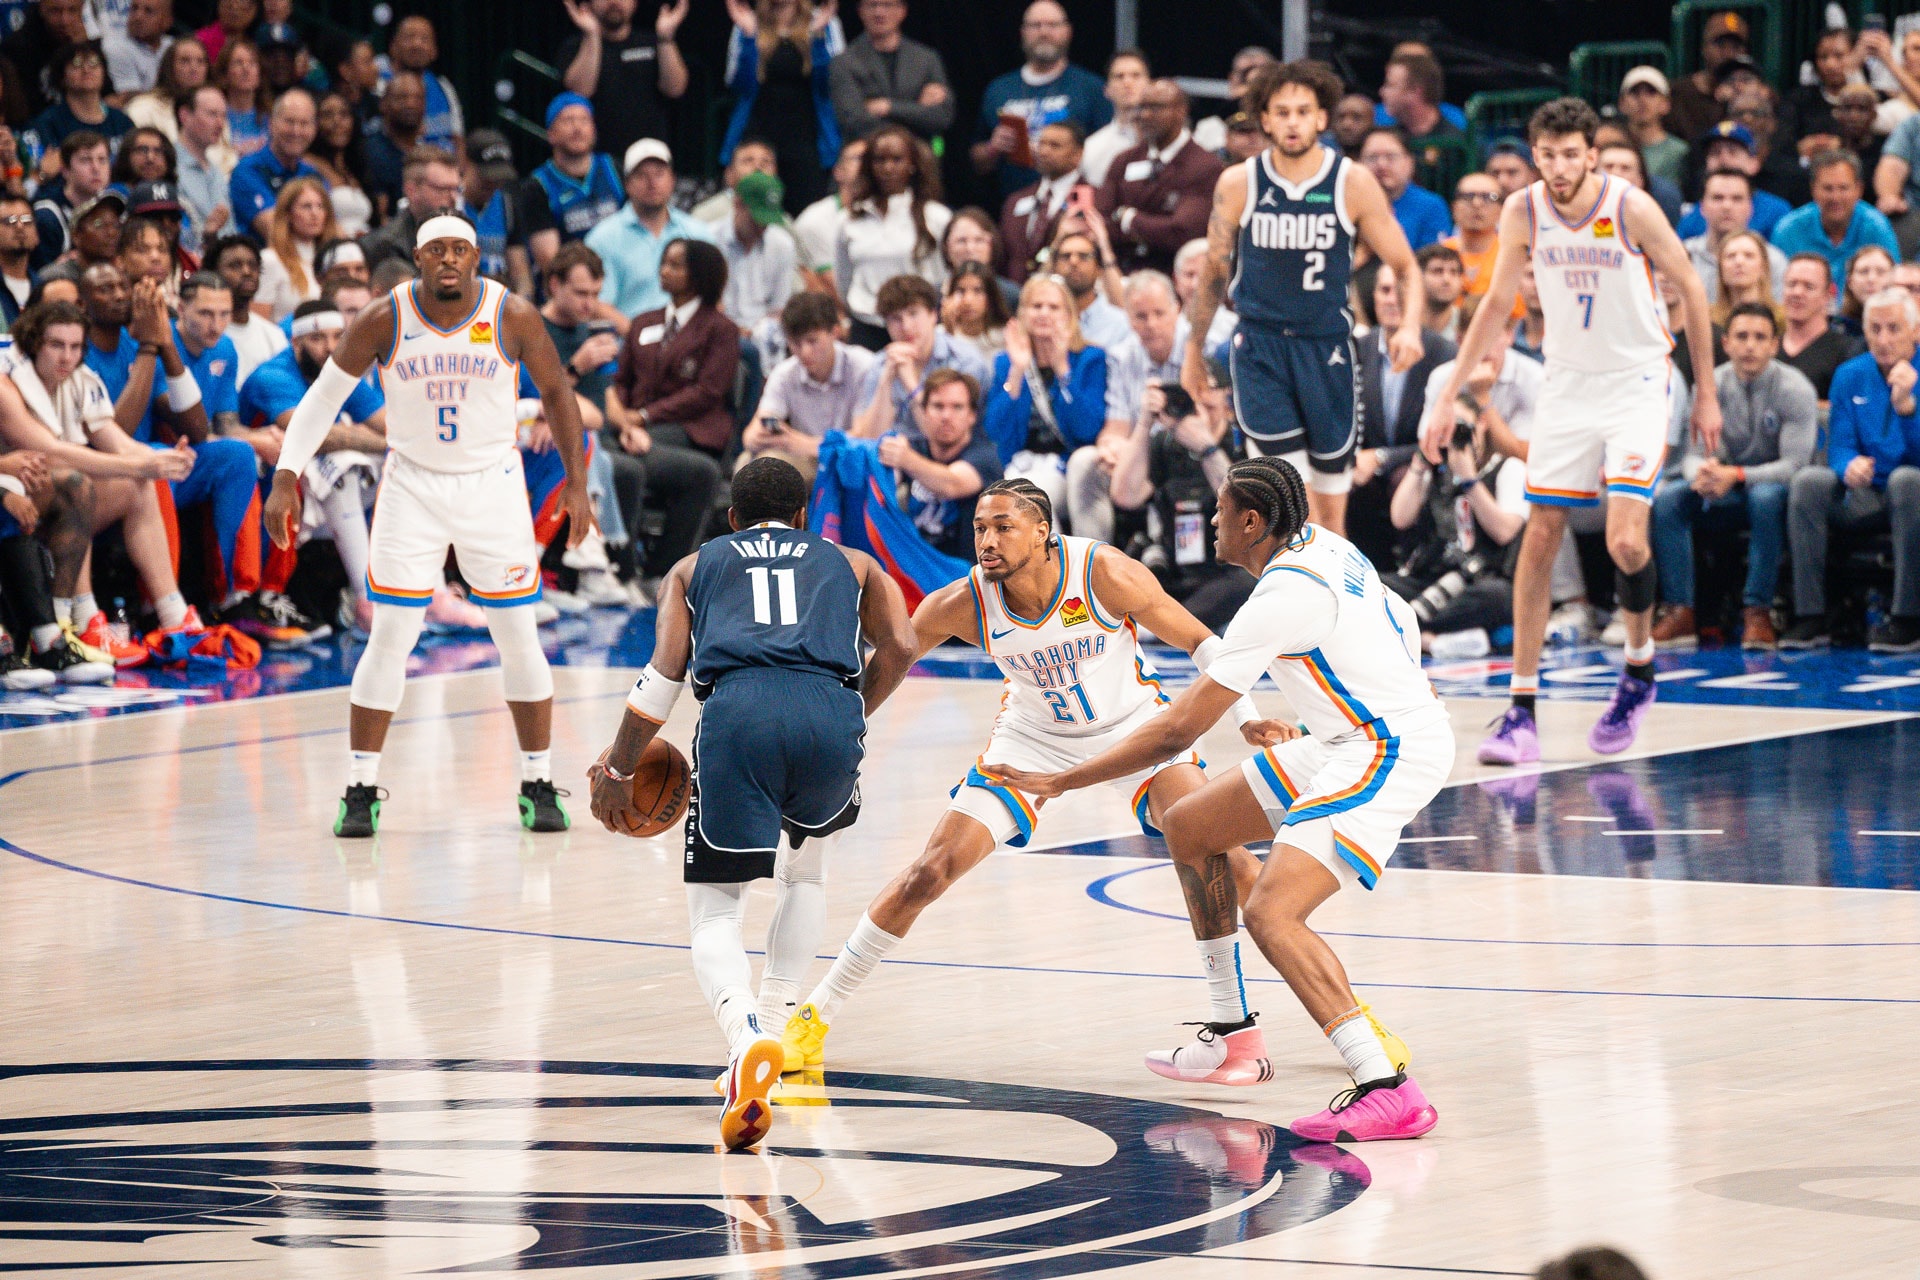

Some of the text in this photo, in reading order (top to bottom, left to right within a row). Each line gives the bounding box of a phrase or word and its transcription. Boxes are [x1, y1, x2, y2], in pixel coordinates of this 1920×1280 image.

[1302, 251, 1326, 291] 2
[1538, 246, 1624, 269] OKLAHOMA
[1564, 270, 1600, 289] CITY
[1577, 293, 1595, 331] 7
[395, 353, 499, 381] OKLAHOMA
[426, 380, 469, 401] CITY
[436, 405, 459, 444] 5
[729, 540, 809, 558] IRVING
[745, 566, 798, 626] 11
[1002, 633, 1107, 671] KLAHOMA
[1033, 661, 1080, 689] CITY
[1041, 682, 1099, 724] 21
